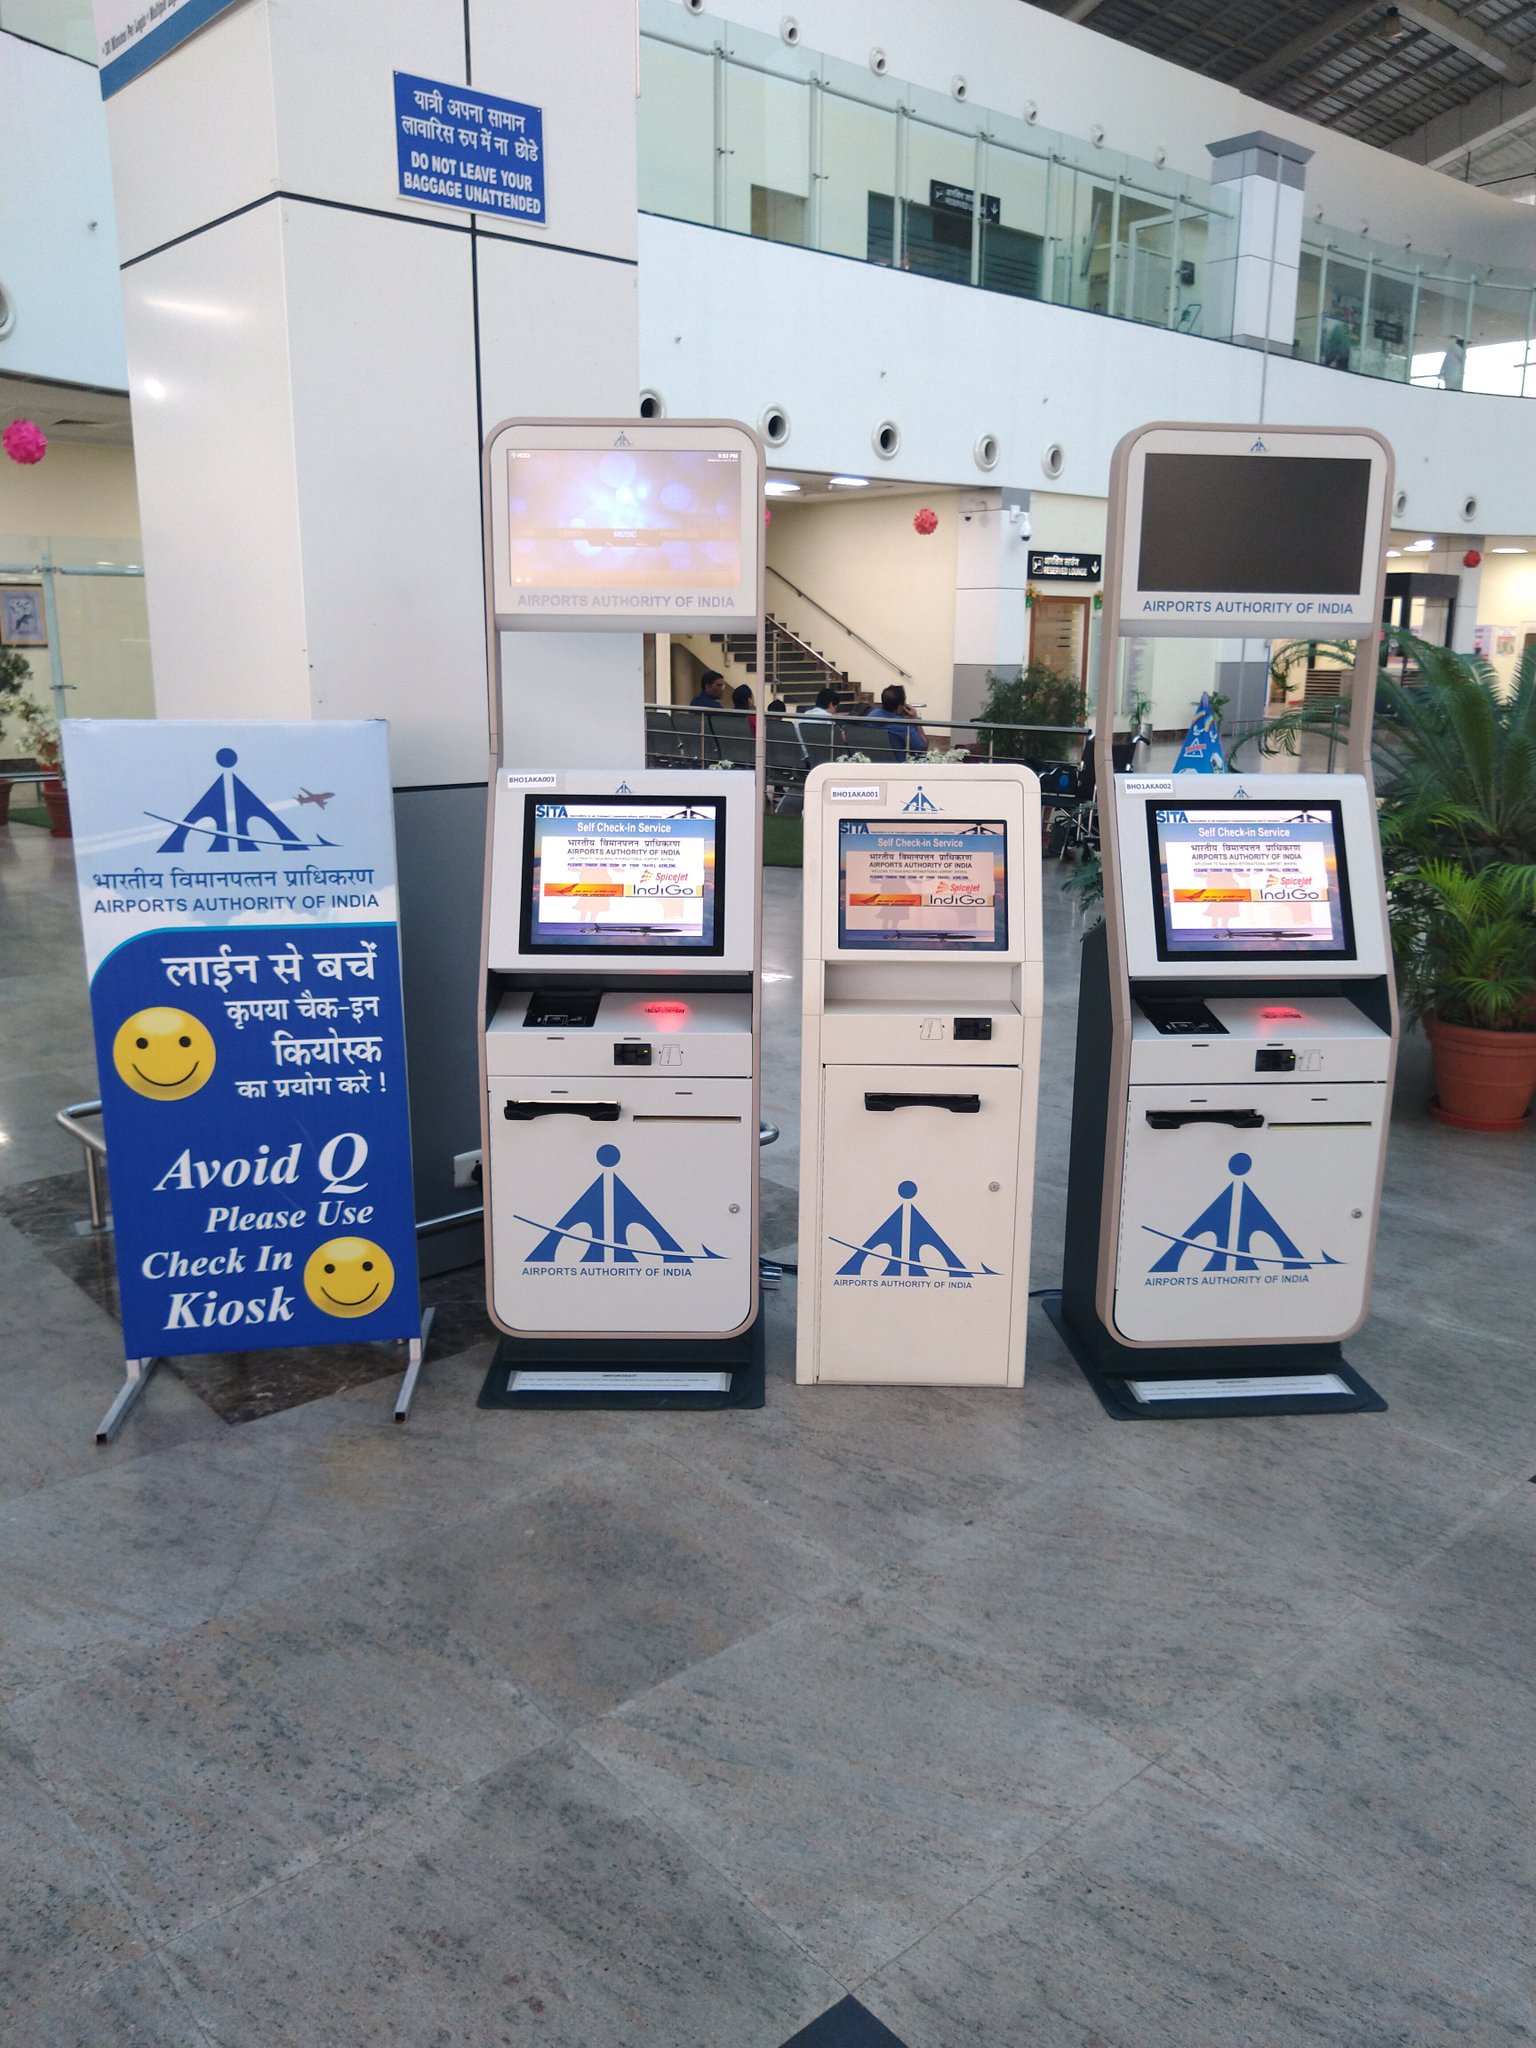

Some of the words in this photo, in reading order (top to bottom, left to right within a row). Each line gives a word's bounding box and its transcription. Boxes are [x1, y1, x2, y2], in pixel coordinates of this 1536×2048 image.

[413, 89, 443, 114] यात्री
[447, 99, 484, 124] अपना
[487, 108, 526, 133] सामान
[401, 115, 454, 144] लावारिस
[480, 128, 492, 152] में
[494, 137, 508, 156] ना
[411, 151, 429, 170] DO
[432, 155, 457, 176] NOT
[459, 161, 497, 185] LEAVE
[500, 169, 533, 192] YOUR
[403, 172, 463, 199] BAGGAGE
[464, 185, 541, 214] UNATTENDED
[517, 594, 588, 607] AIRPORTS
[591, 595, 671, 608] AUTHORITY
[675, 596, 693, 608] OF
[698, 596, 735, 608] INDIA
[1142, 600, 1212, 612] AIRPORTS
[1215, 601, 1293, 614] AUTHORITY
[1296, 602, 1314, 614] OF
[1318, 603, 1353, 614] INDIA
[536, 804, 568, 818] SITA
[1156, 810, 1189, 823] SITA
[577, 822, 595, 832] Self
[597, 822, 636, 832] Check-in
[638, 823, 671, 833] Service
[840, 822, 869, 834] SITA
[1198, 827, 1215, 837] Self
[1217, 827, 1256, 837] Check-in
[1257, 827, 1290, 837] Service
[878, 838, 894, 847] Self
[895, 838, 931, 847] Check-in
[933, 838, 963, 848] Service
[93, 867, 163, 889] भारतीय
[170, 867, 277, 888] विमानपत्तन
[282, 864, 375, 887] प्राधिकरण
[633, 884, 694, 895] IndiGo
[1260, 888, 1319, 900] IndiGo
[94, 898, 188, 913] AIRPORTS
[193, 896, 296, 912] AUTHORITY
[302, 895, 326, 909] OF
[332, 894, 380, 908] INDIA
[930, 894, 985, 905] IndiGo
[160, 944, 260, 993] लाईन
[267, 942, 304, 984] से
[312, 940, 378, 981] बचें
[223, 998, 289, 1031] कृपया
[271, 1027, 383, 1067] कियोस्क
[234, 1080, 268, 1099] का
[273, 1071, 332, 1098] प्रयोग
[153, 1143, 302, 1192] Avoid
[318, 1132, 369, 1194] Q
[204, 1205, 306, 1233] Please
[318, 1200, 374, 1227] Use
[142, 1247, 246, 1280] Check
[254, 1245, 293, 1273] In
[522, 1267, 578, 1276] AIRPORTS
[580, 1268, 642, 1277] AUTHORITY
[645, 1268, 660, 1277] OF
[663, 1268, 692, 1277] INDIA
[1144, 1277, 1199, 1286] AIRPORTS
[1201, 1276, 1261, 1285] AUTHORITY
[1264, 1275, 1279, 1284] OF
[1281, 1274, 1310, 1283] INDIA
[833, 1279, 879, 1287] AIRPORTS
[881, 1280, 932, 1288] AUTHORITY
[934, 1281, 946, 1289] OF
[949, 1281, 972, 1289] INDIA
[162, 1286, 296, 1331] Kiosk
